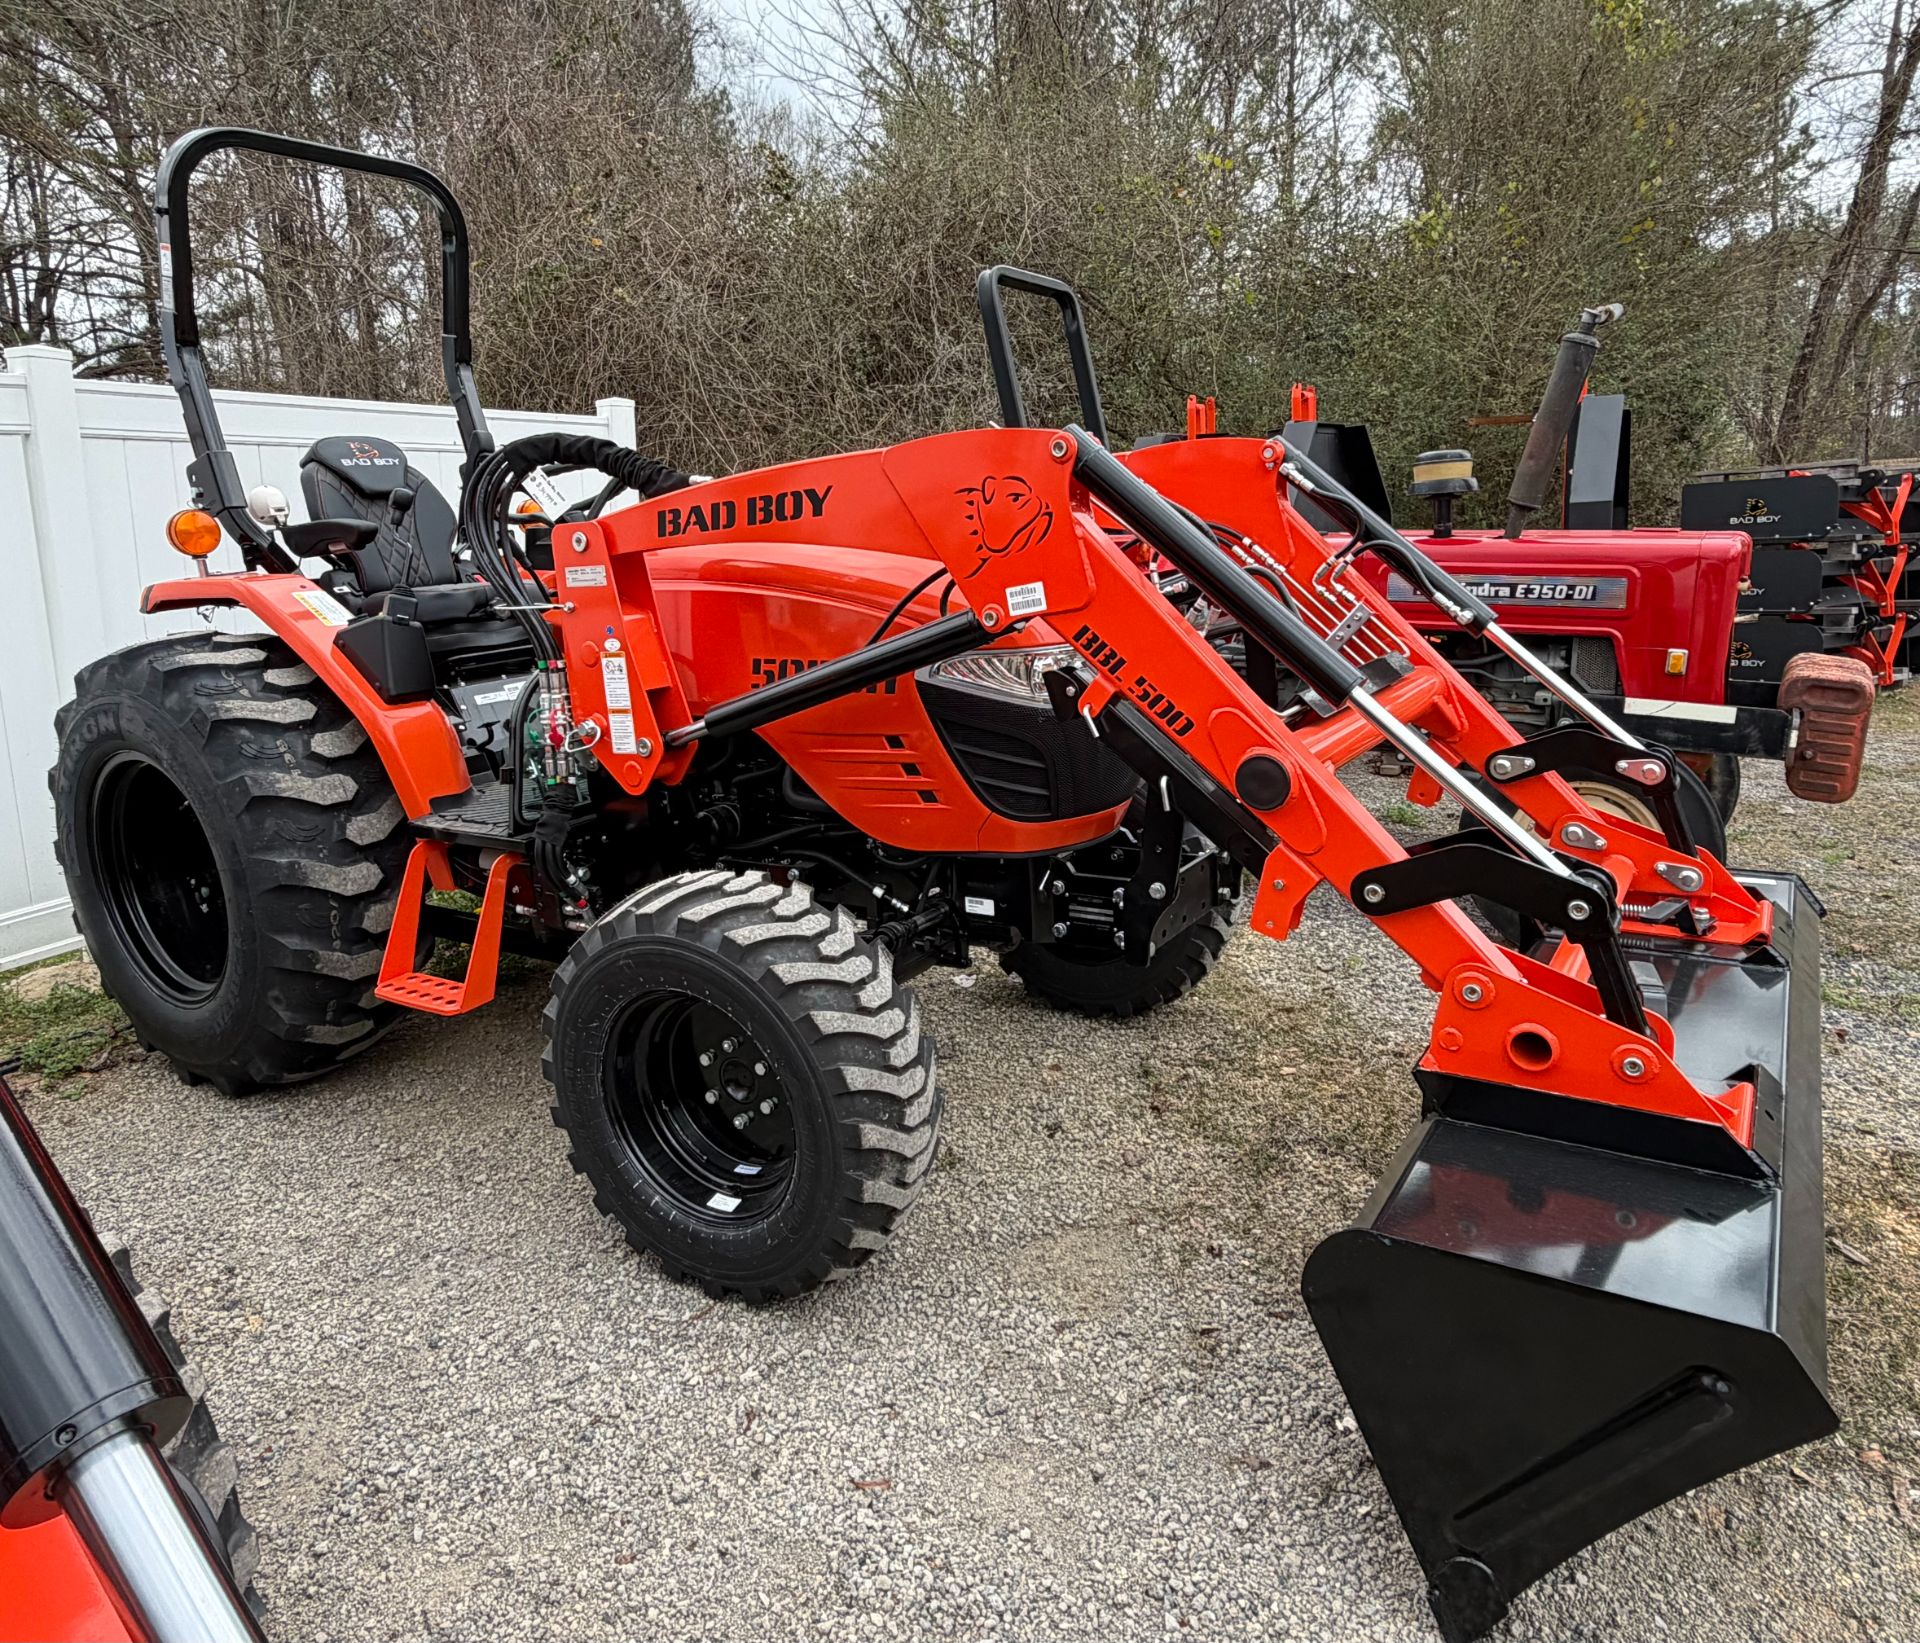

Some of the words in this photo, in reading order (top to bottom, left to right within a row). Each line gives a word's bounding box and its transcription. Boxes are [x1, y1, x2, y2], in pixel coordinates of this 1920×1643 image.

[341, 458, 371, 466] BAD
[657, 500, 737, 539] BAD
[746, 485, 834, 527] BOY
[1729, 516, 1754, 525] BAD
[1756, 515, 1782, 524] BOY
[1515, 584, 1594, 600] E350-DI
[1071, 624, 1128, 683] BBL
[1127, 675, 1196, 737] 500
